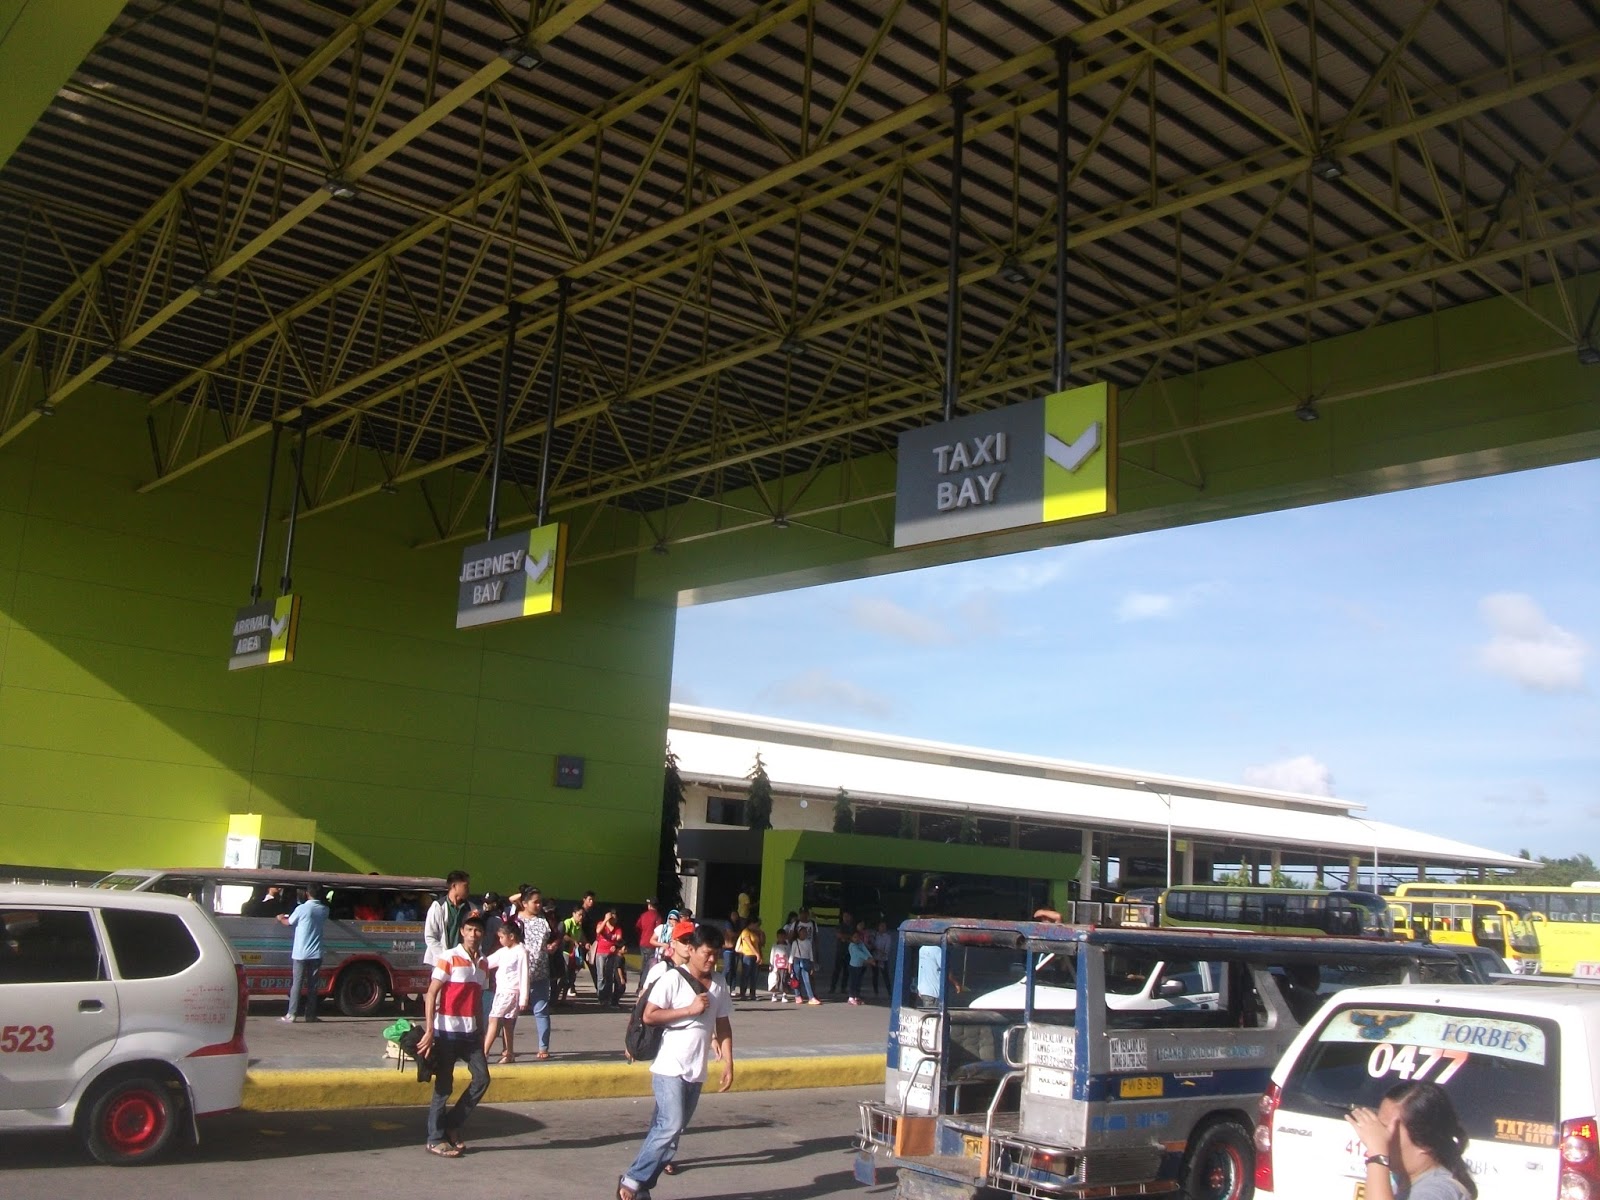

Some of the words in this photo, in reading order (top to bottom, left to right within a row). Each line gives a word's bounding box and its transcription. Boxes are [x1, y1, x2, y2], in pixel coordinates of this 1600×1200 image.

[932, 432, 1007, 474] TAXI
[937, 472, 1001, 511] BAY
[459, 549, 526, 582] JEEPNEY
[472, 580, 504, 605] BAY
[233, 614, 270, 636] ARRIVAL
[235, 635, 262, 654] AREA
[0, 1025, 54, 1052] 523
[1440, 1022, 1529, 1053] FORBES
[1367, 1043, 1470, 1085] 0477
[1495, 1119, 1526, 1136] TXT
[1345, 1140, 1368, 1158] 41
